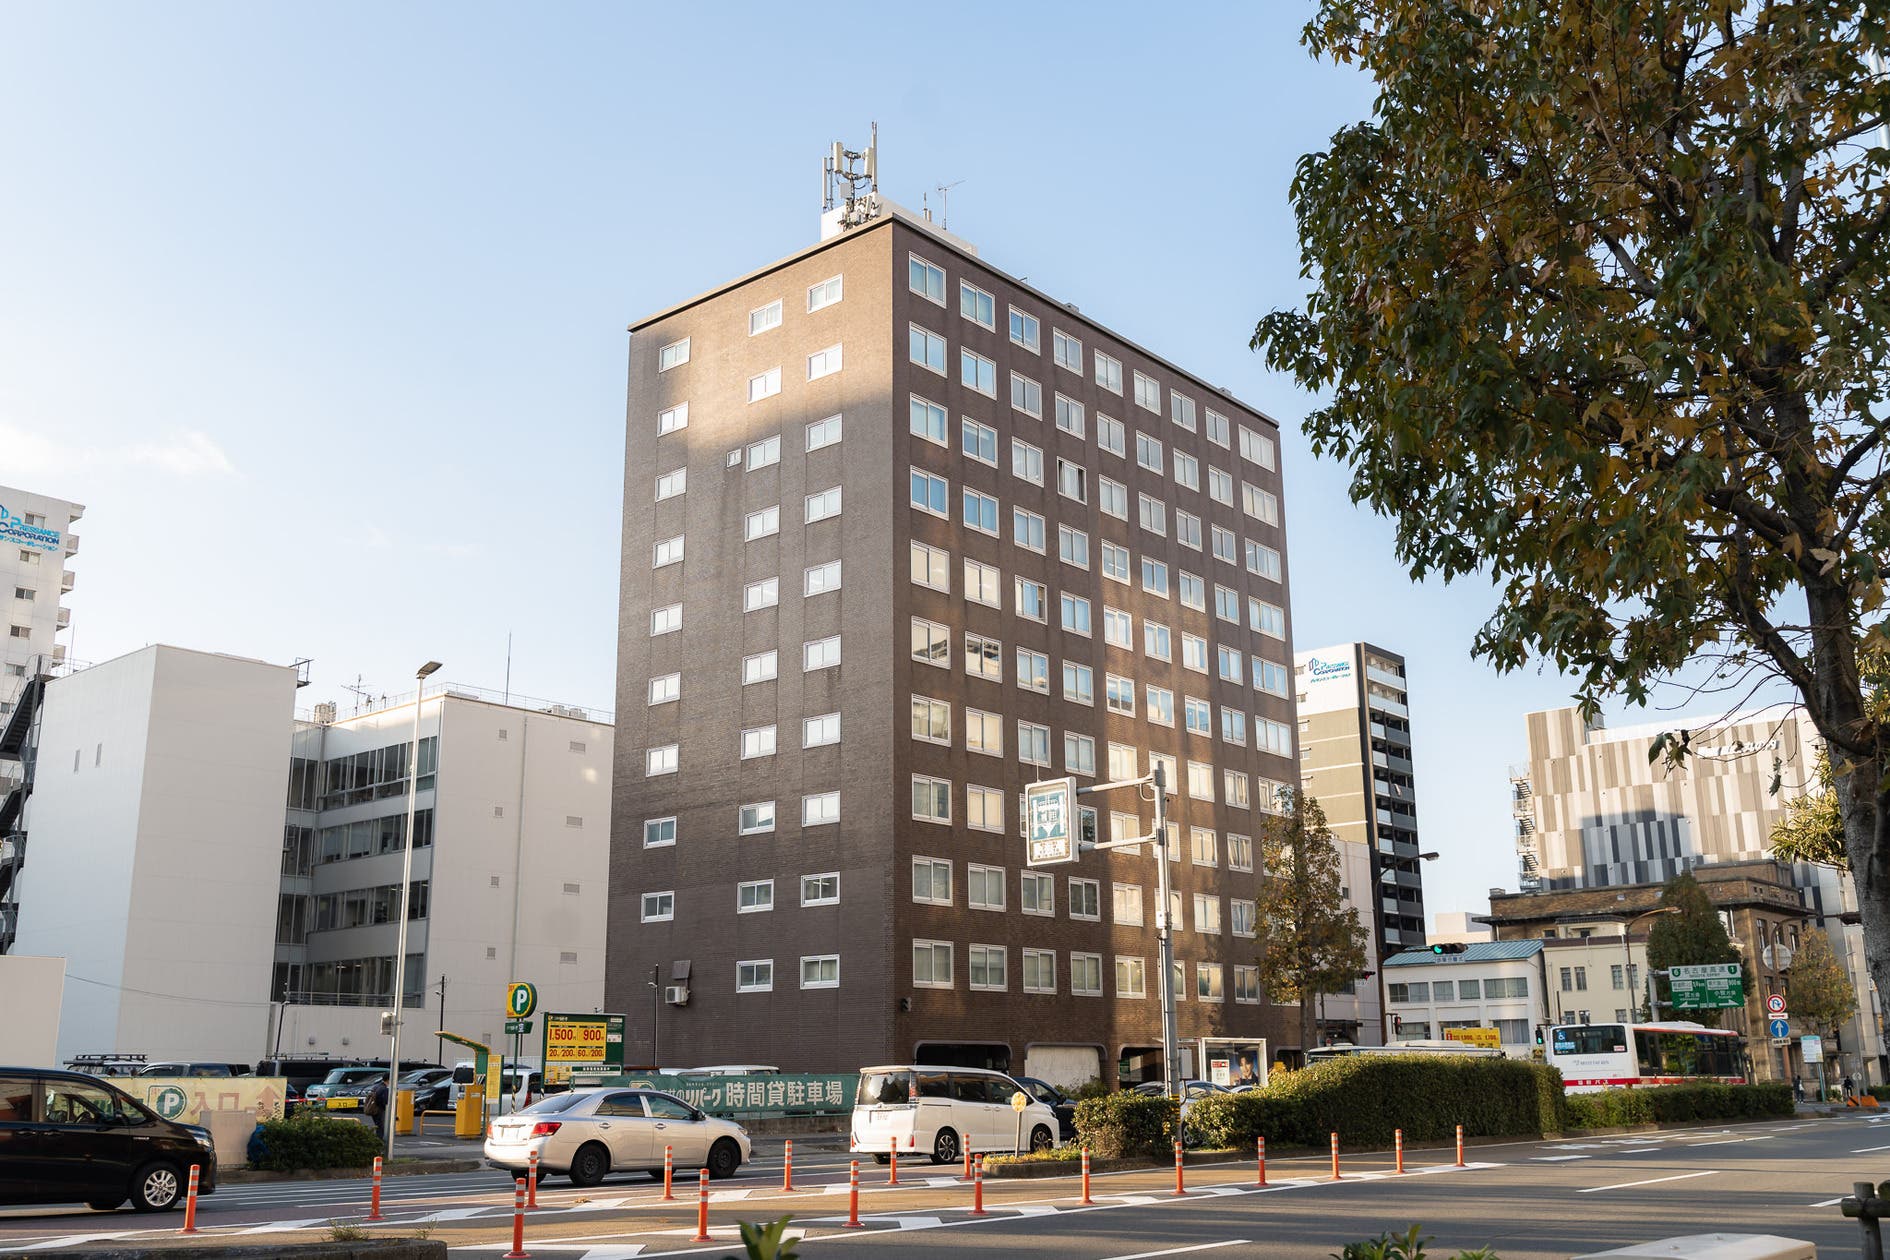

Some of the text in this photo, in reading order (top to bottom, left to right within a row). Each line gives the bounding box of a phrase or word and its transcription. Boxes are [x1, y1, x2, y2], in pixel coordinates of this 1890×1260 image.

[516, 989, 528, 1011] P
[163, 1091, 240, 1117] P 入口
[725, 1080, 843, 1108] 時間貸駐車場
